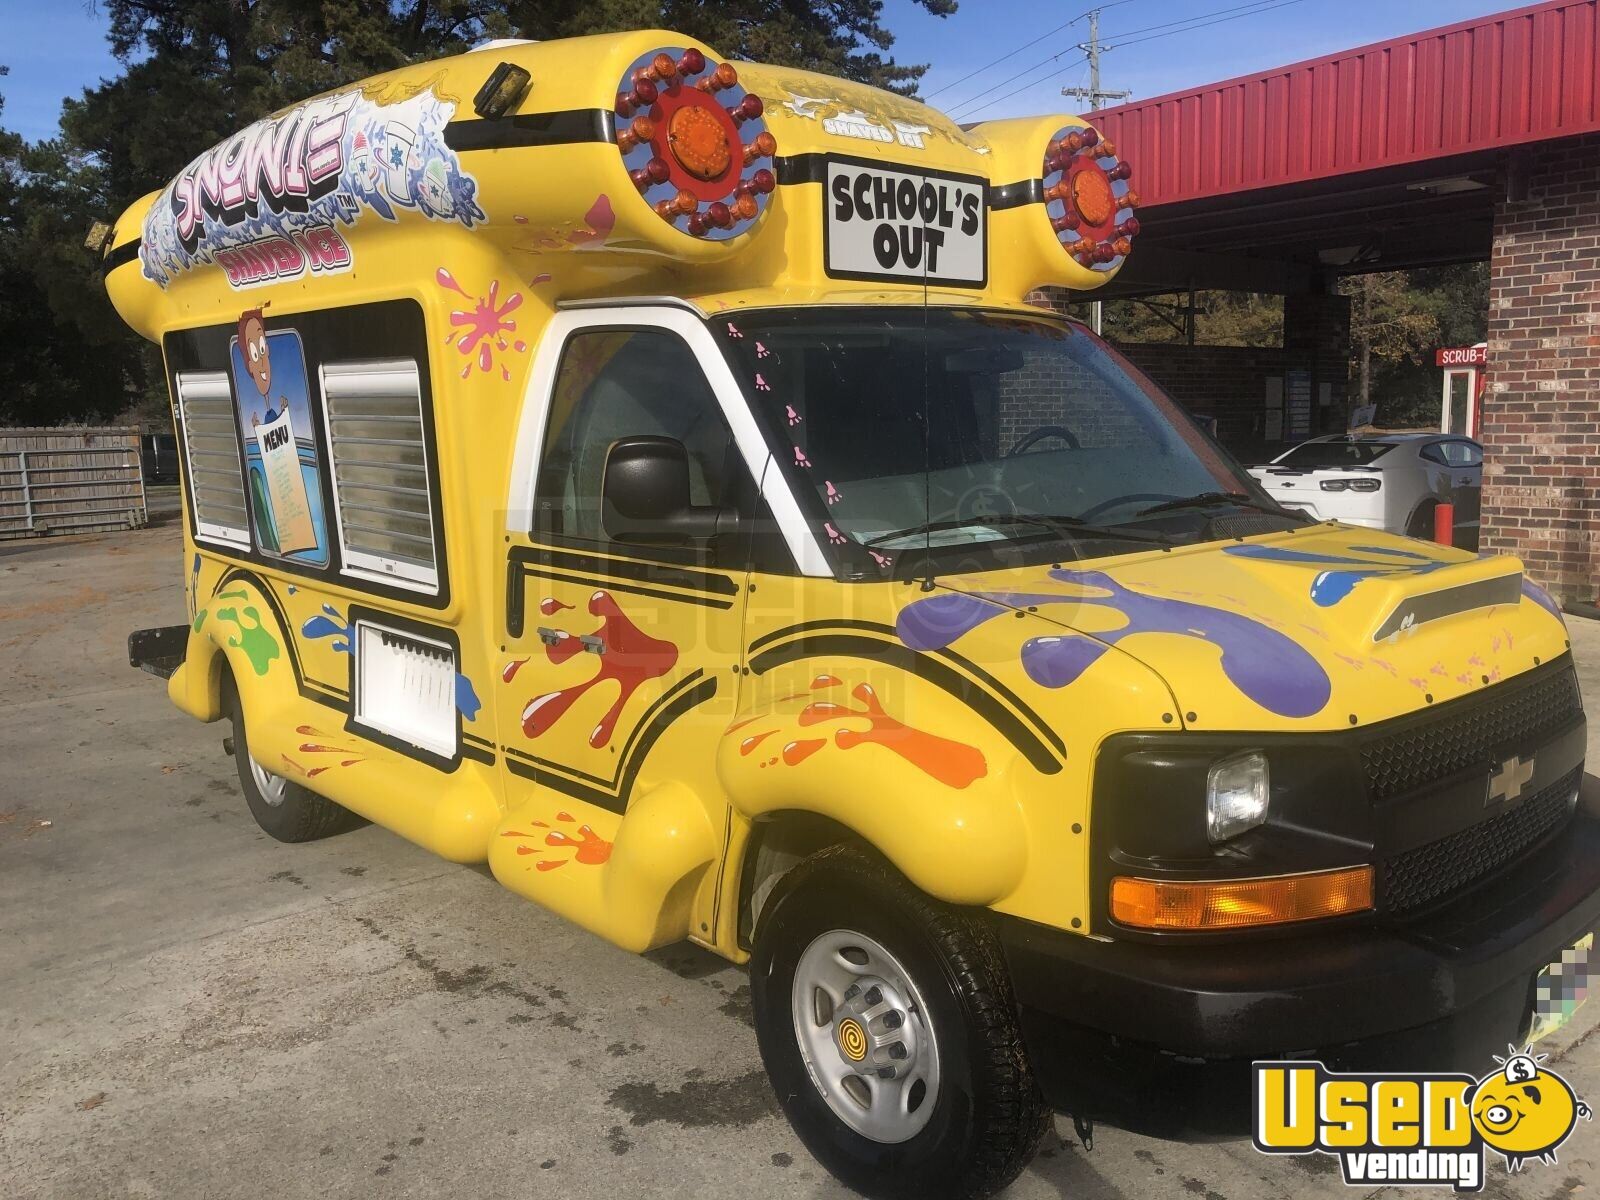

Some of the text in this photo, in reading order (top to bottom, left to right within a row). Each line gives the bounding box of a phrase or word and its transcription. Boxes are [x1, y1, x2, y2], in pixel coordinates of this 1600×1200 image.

[336, 194, 355, 210] TM
[832, 172, 980, 237] SCHOOL'S
[215, 225, 349, 283] SHAVED ICE
[873, 223, 945, 273] OUT
[263, 424, 289, 453] MENU
